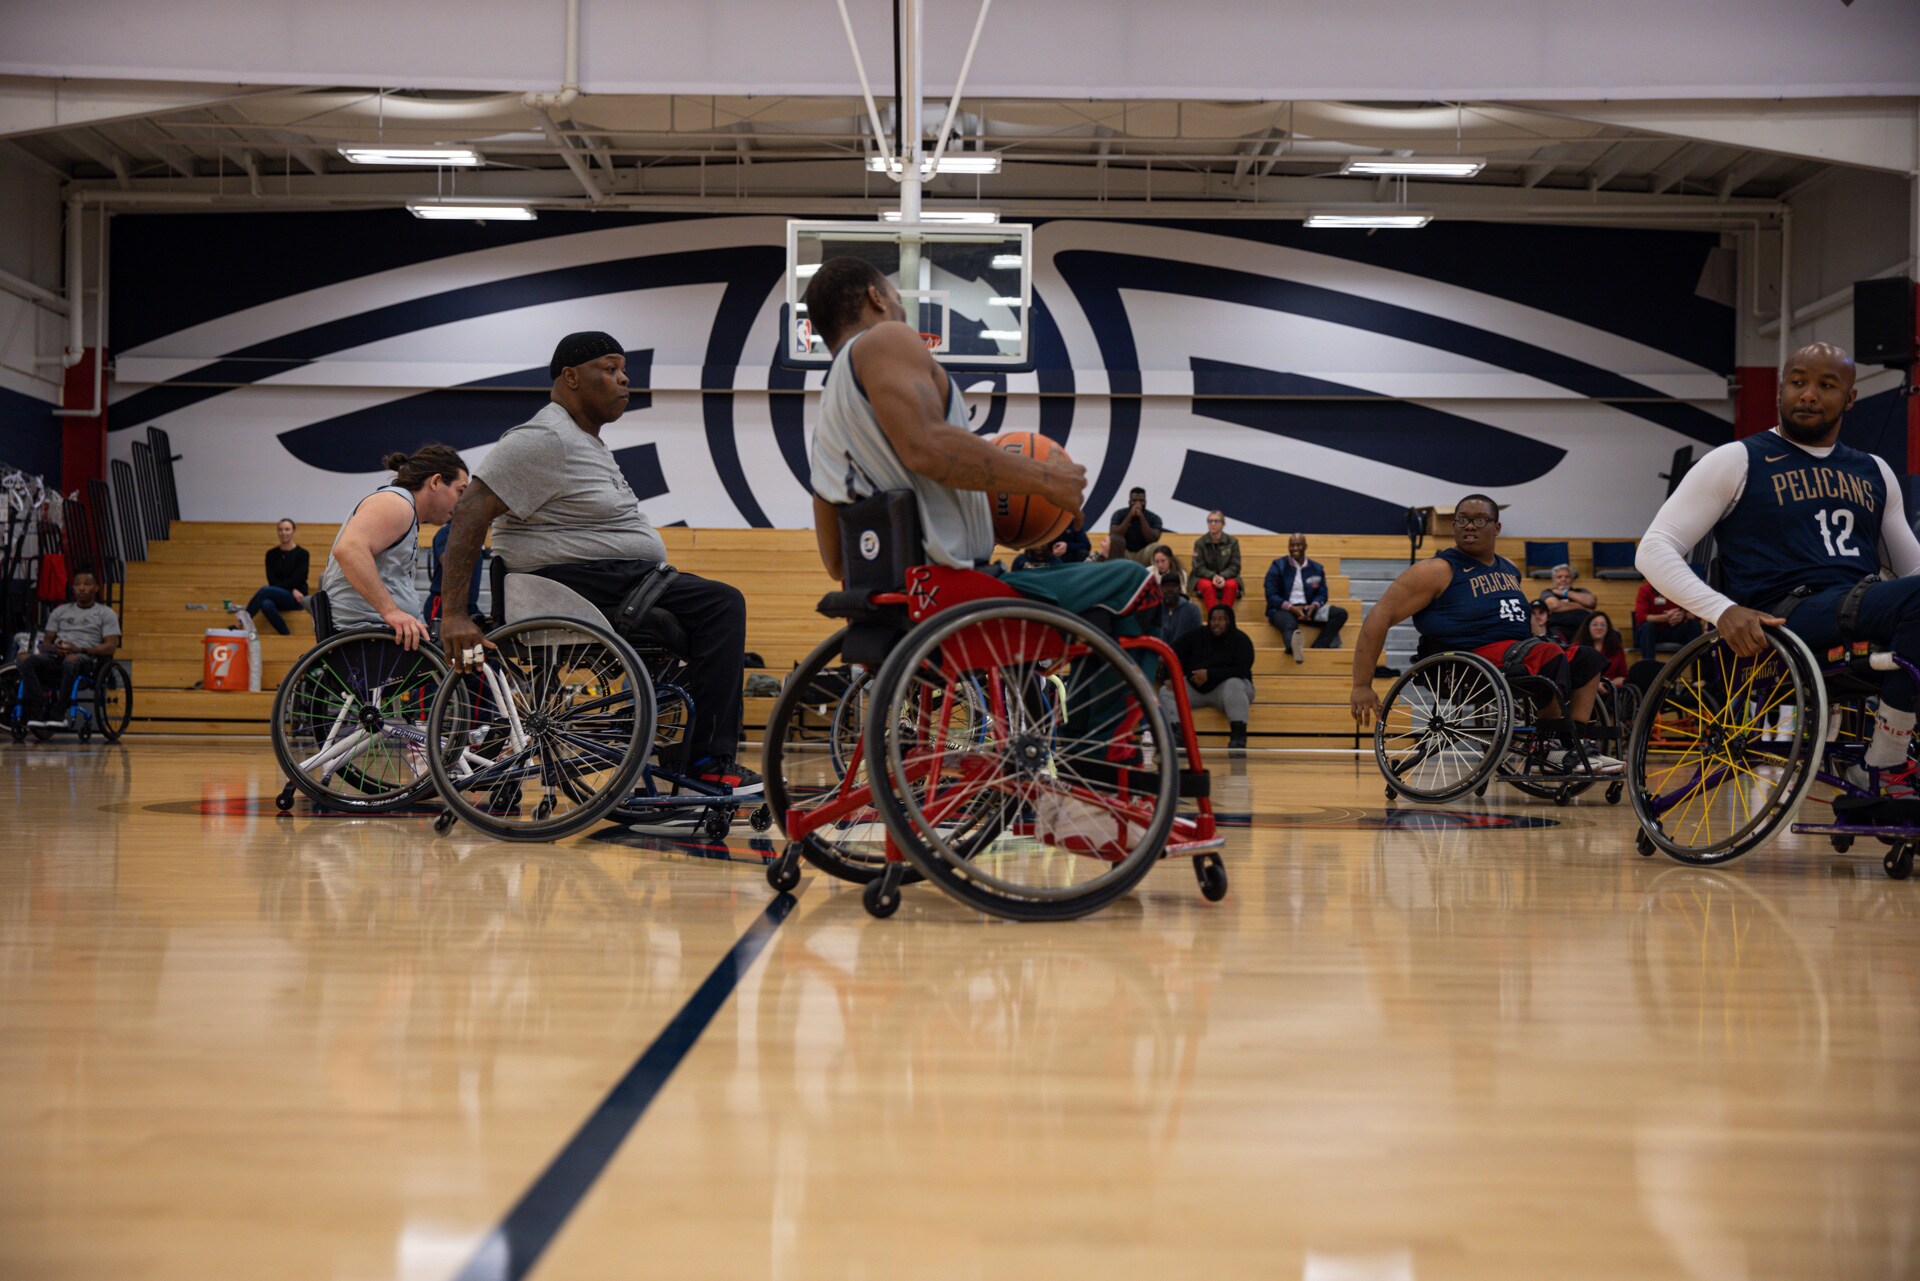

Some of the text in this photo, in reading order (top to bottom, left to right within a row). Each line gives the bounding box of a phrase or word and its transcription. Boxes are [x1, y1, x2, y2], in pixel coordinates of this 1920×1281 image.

[1771, 466, 1875, 513] PELICANS
[1814, 508, 1860, 557] 12
[1469, 571, 1521, 598] PELICAN
[1499, 598, 1527, 622] 45
[213, 645, 228, 662] G
